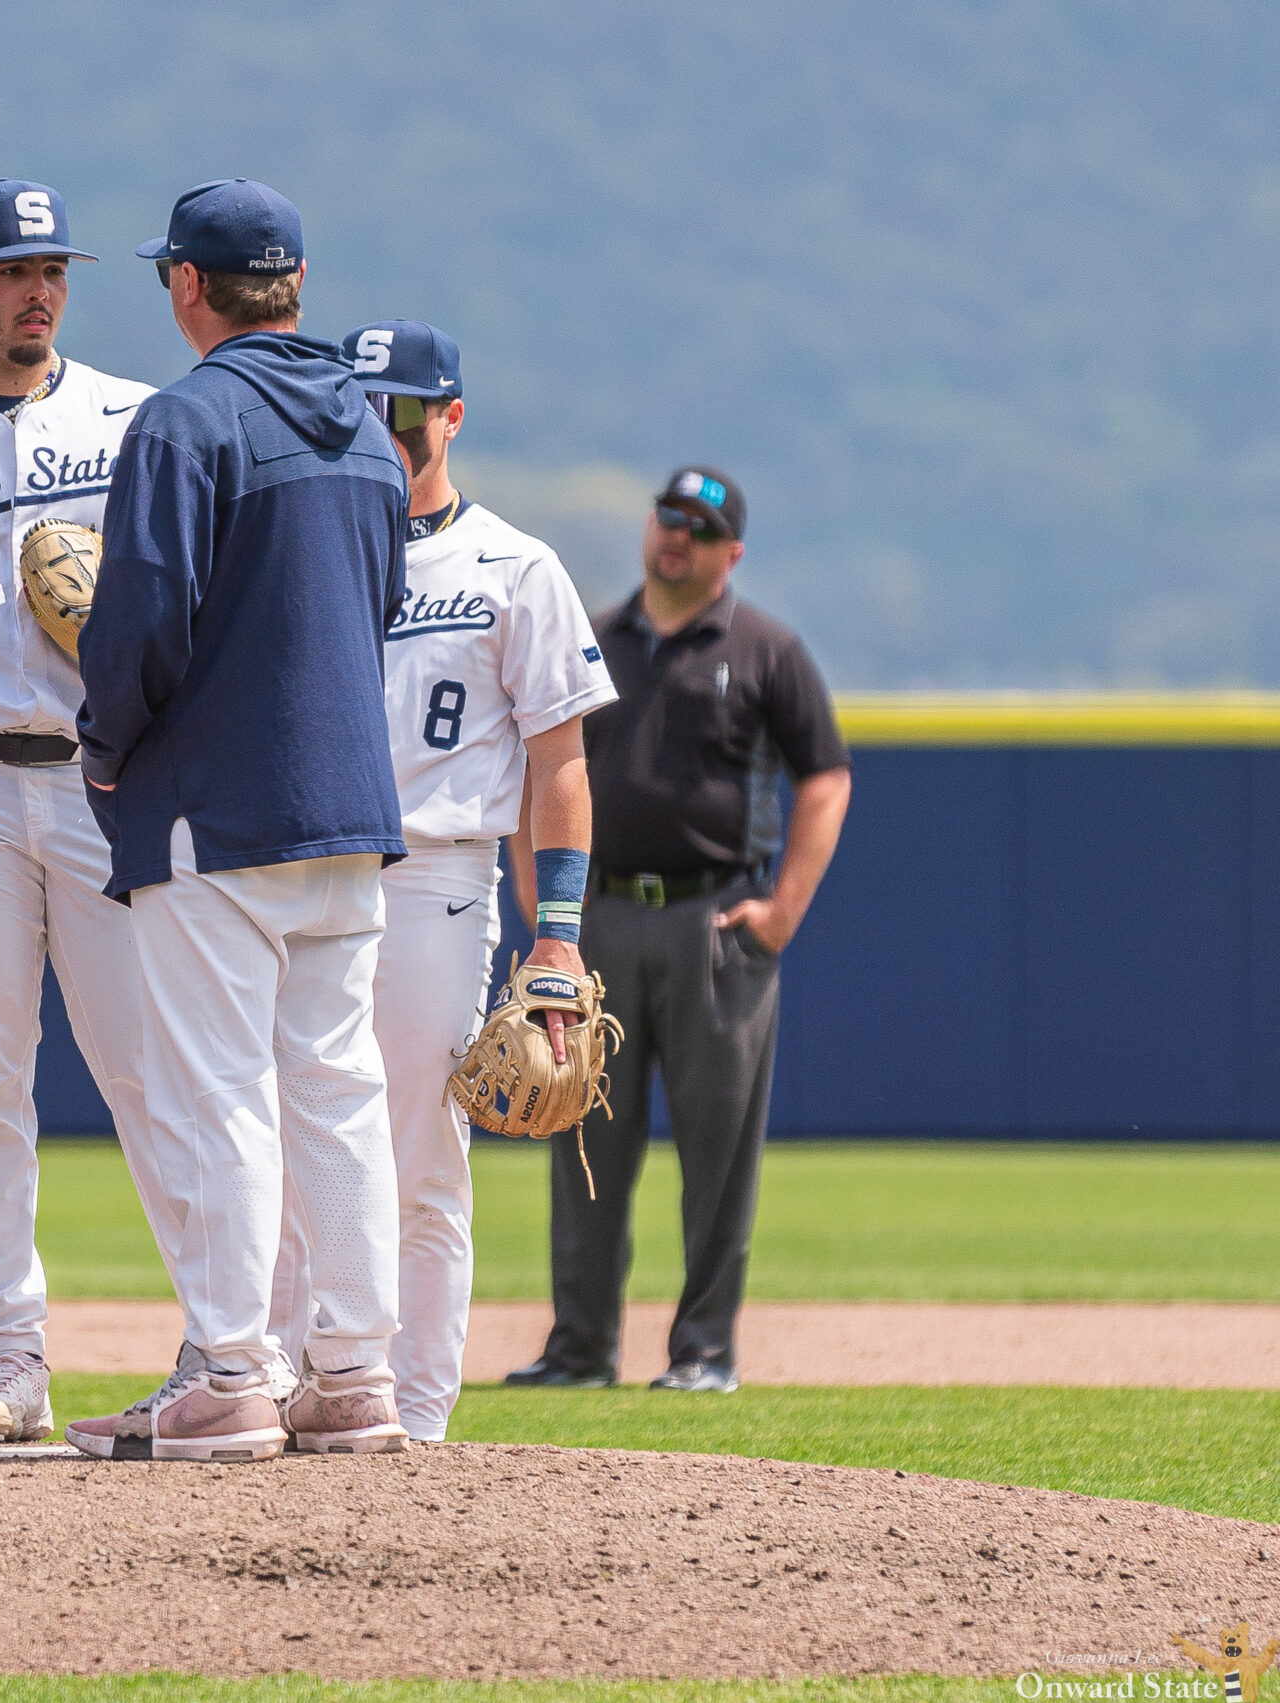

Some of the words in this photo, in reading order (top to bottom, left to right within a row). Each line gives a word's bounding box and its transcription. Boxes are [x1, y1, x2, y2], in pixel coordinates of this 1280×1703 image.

[14, 191, 55, 236] S
[249, 259, 274, 269] PENN
[275, 257, 296, 269] STATE
[354, 329, 394, 373] S
[423, 679, 467, 751] 8
[531, 981, 576, 996] Wilson
[520, 1085, 541, 1124] A2000
